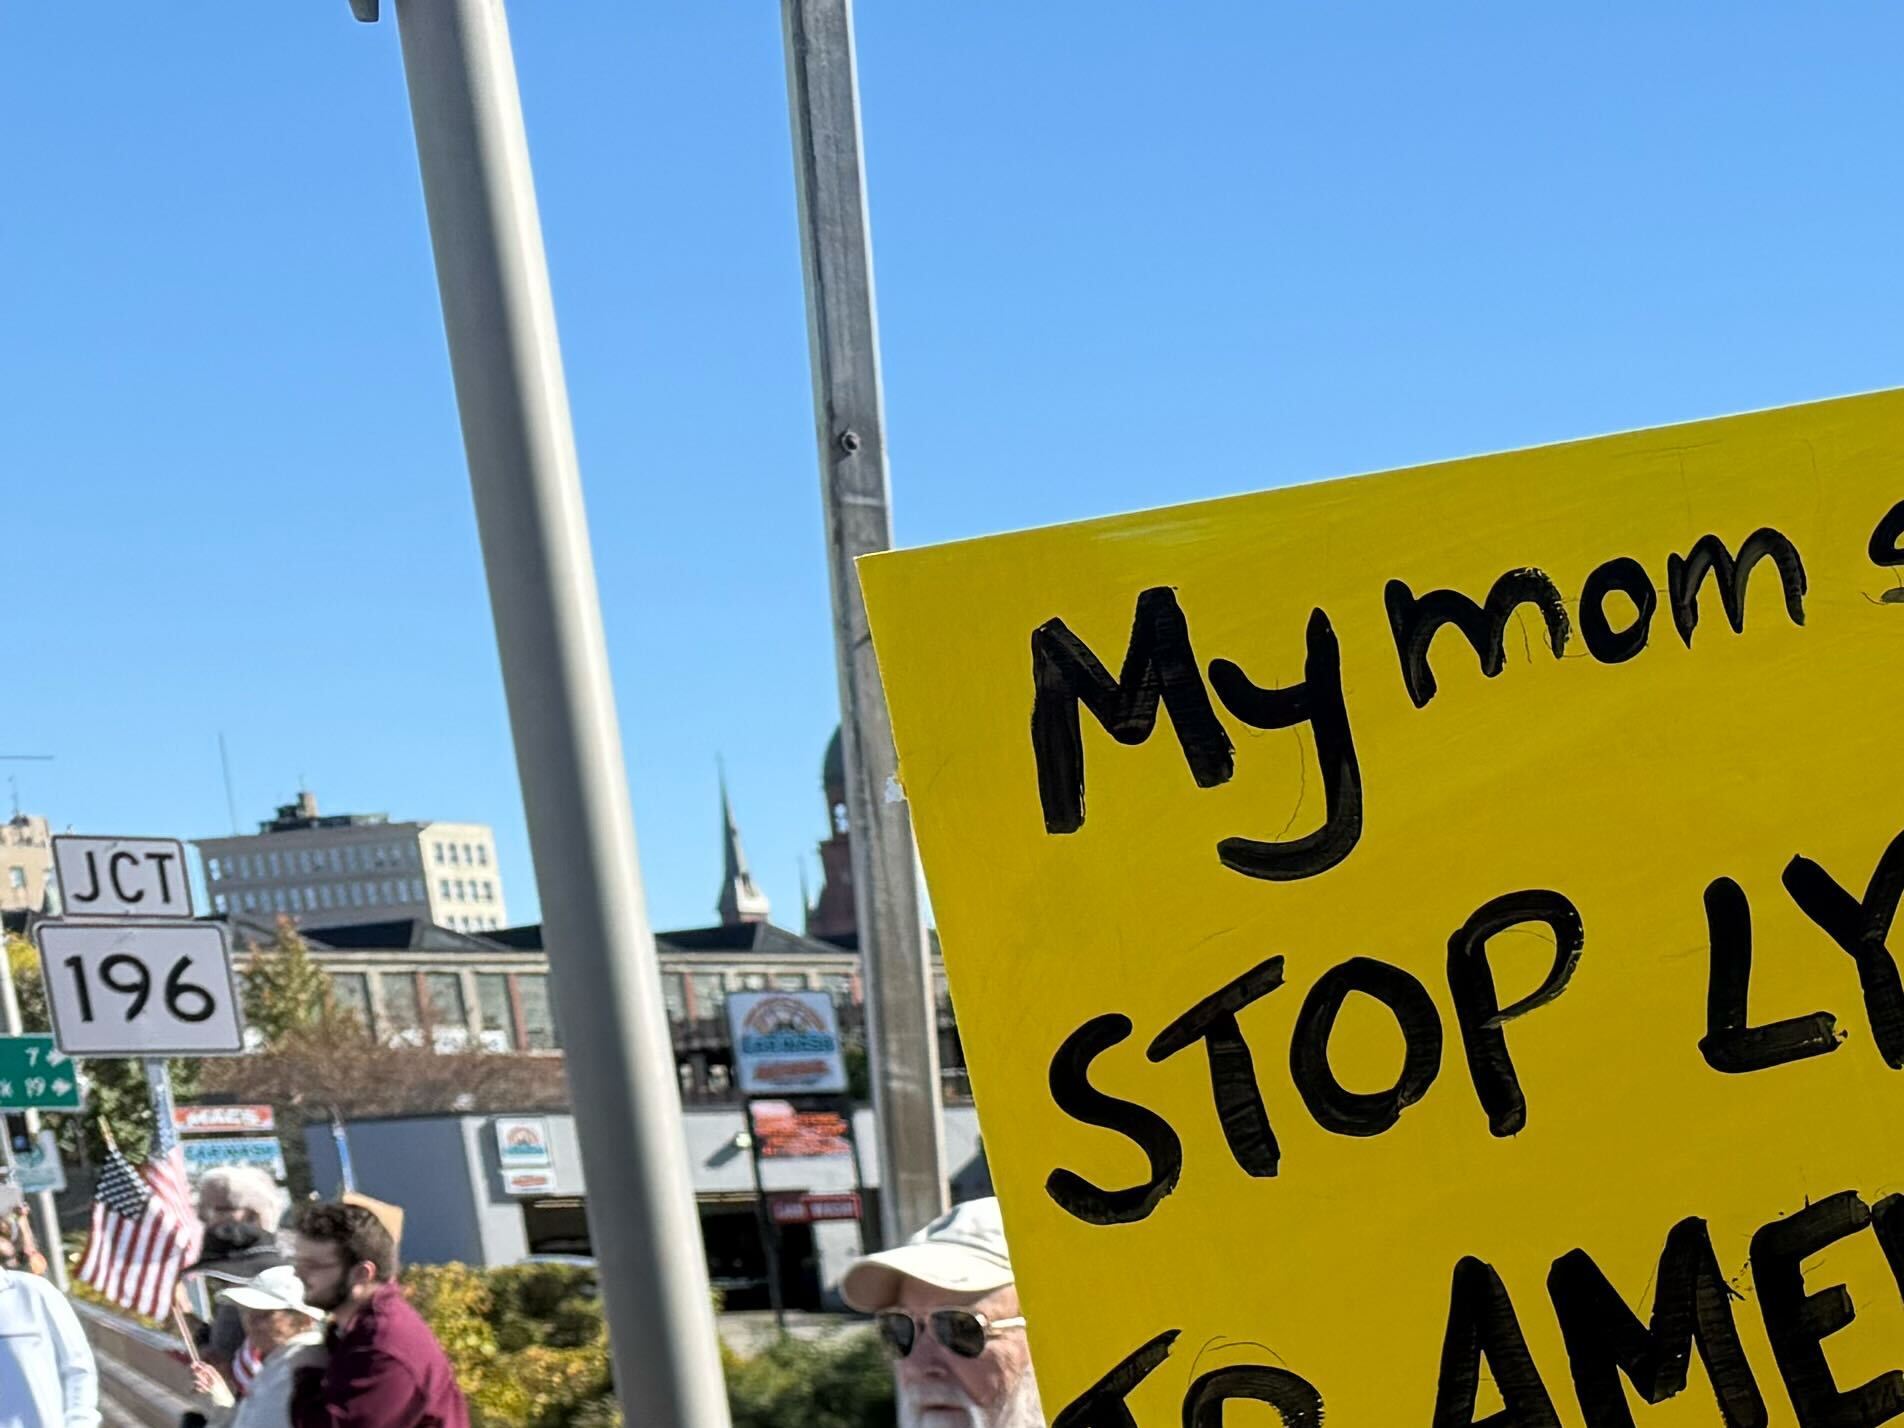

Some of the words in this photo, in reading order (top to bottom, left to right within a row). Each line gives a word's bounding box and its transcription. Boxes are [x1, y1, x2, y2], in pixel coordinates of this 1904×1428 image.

[1030, 586, 1364, 882] My
[1384, 527, 1808, 709] mom
[74, 851, 175, 904] JCT
[64, 953, 217, 1023] 196
[1046, 889, 1586, 1226] STOP
